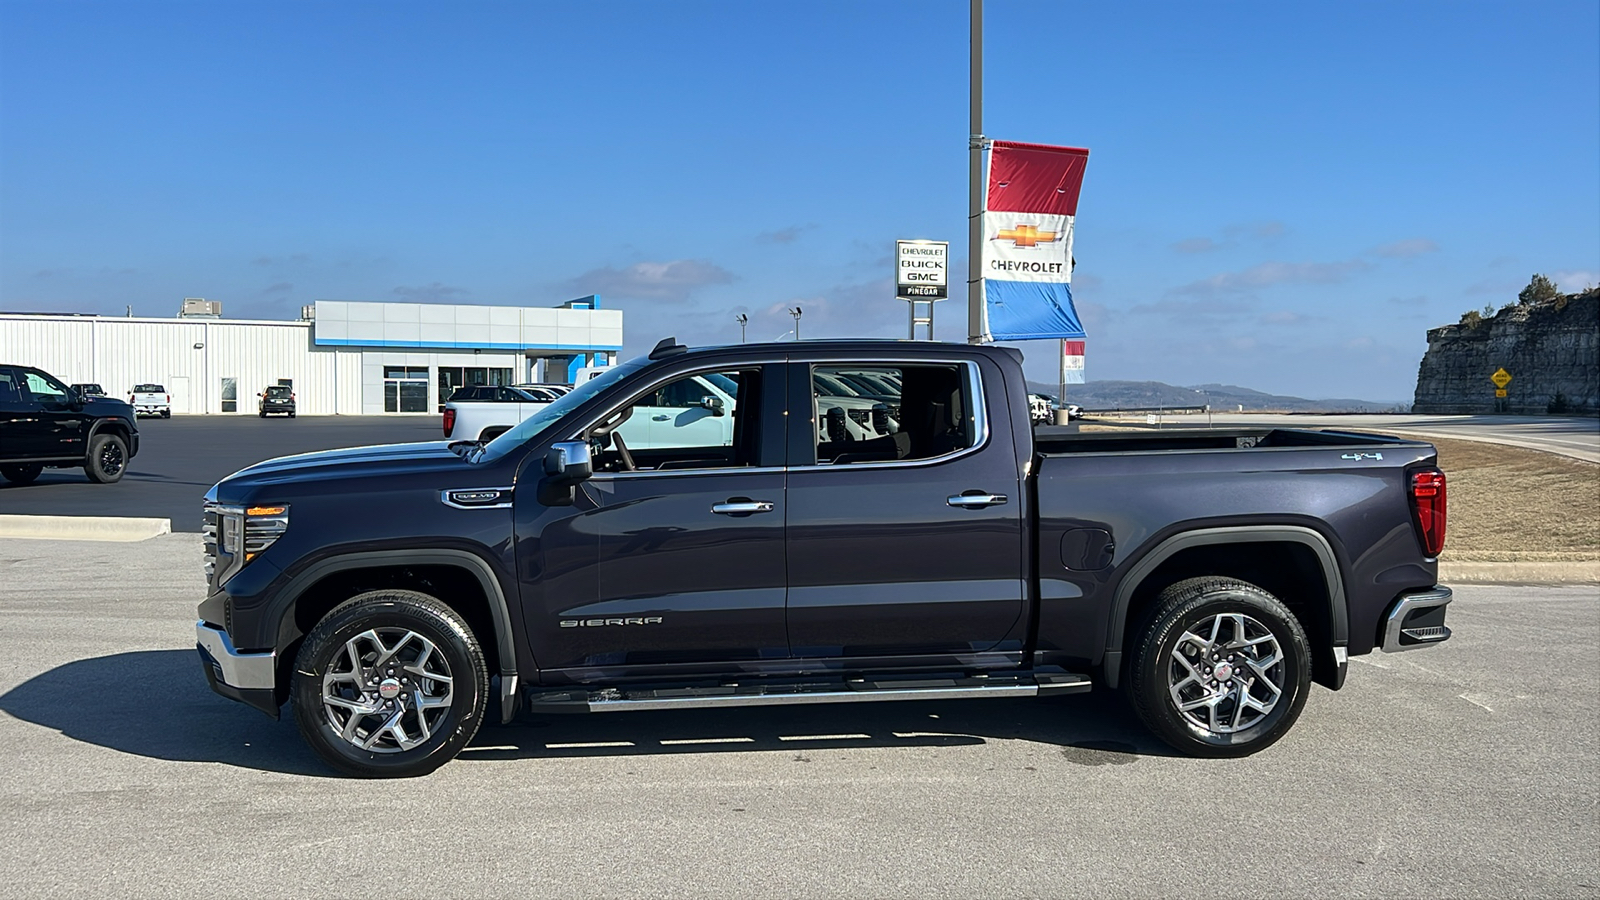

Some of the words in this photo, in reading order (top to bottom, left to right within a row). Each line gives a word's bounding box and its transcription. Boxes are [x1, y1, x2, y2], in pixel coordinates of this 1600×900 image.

[902, 247, 943, 256] CHEVROLET
[901, 260, 943, 269] BUICK
[991, 259, 1063, 274] CHEVROLET
[907, 272, 938, 281] GMC
[907, 287, 938, 295] PINEGAR
[398, 605, 459, 642] BRIDGESTONE
[559, 616, 663, 628] SIERRA
